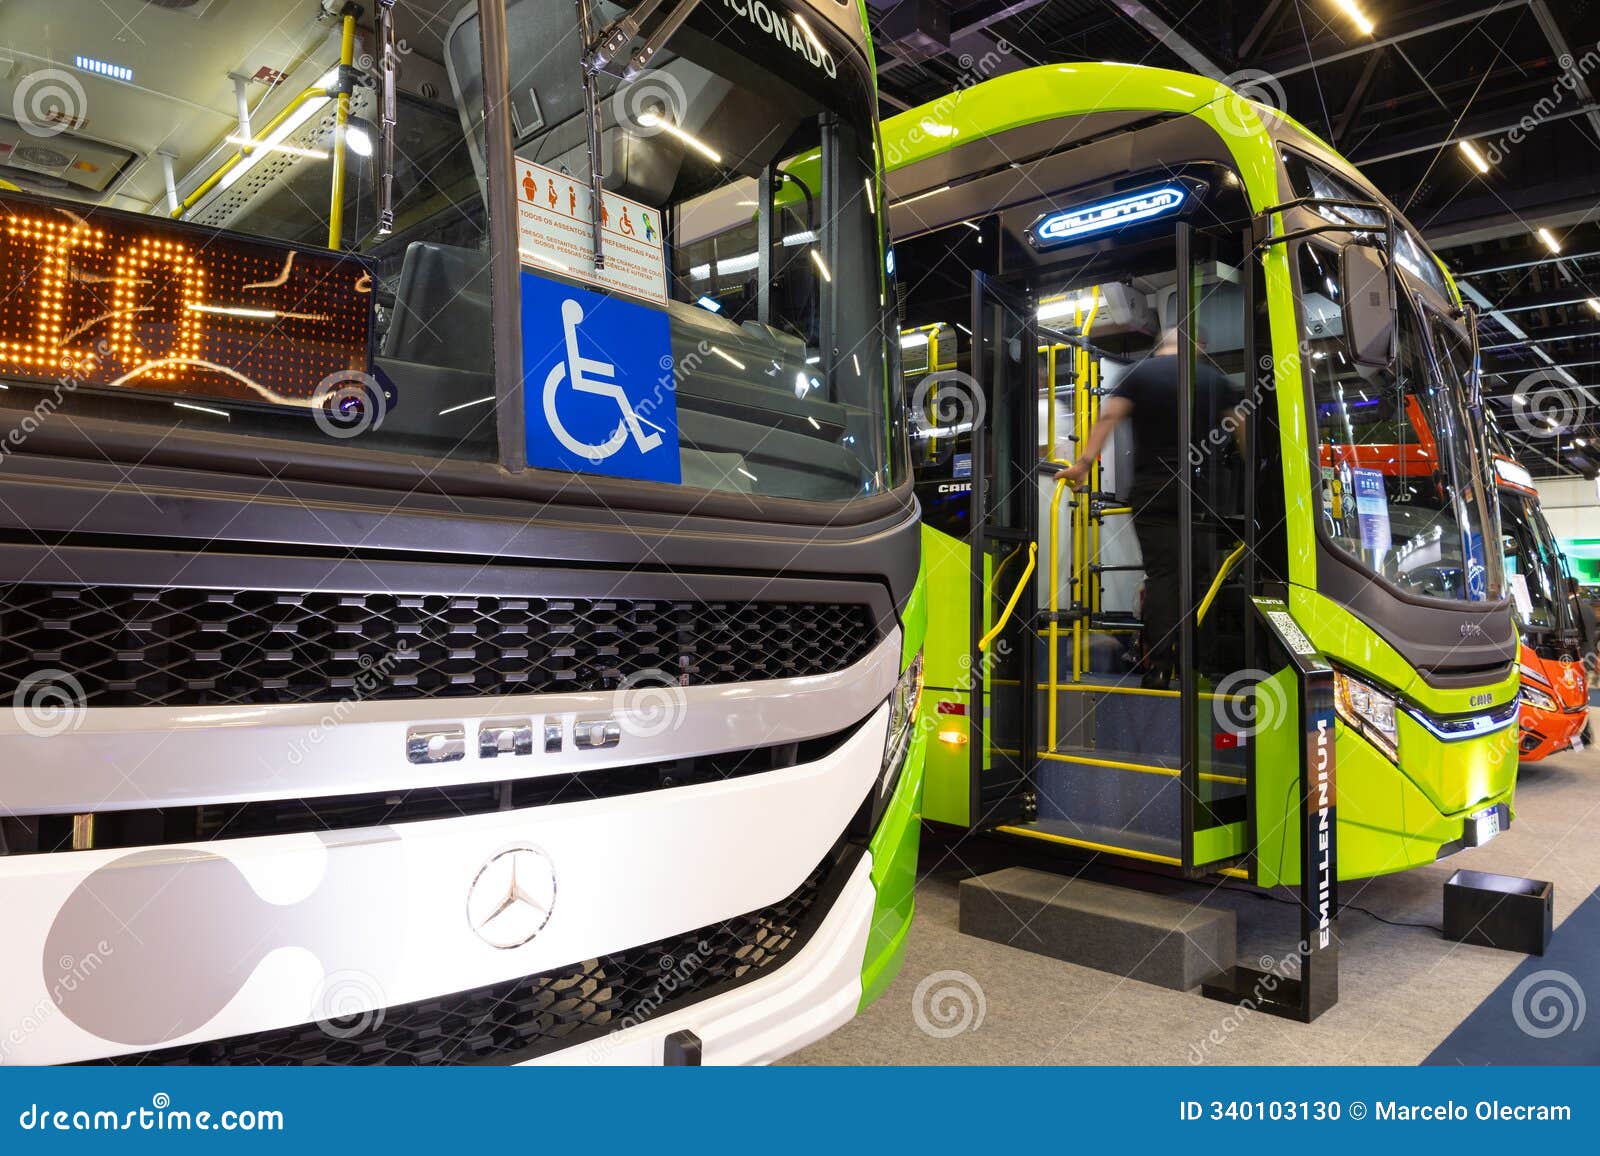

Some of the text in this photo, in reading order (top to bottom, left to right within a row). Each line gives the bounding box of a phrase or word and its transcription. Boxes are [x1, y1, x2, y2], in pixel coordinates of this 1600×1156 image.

[723, 0, 837, 79] CIONADO
[406, 718, 621, 765] CAIO
[1317, 719, 1331, 950] EMILLENNIUM
